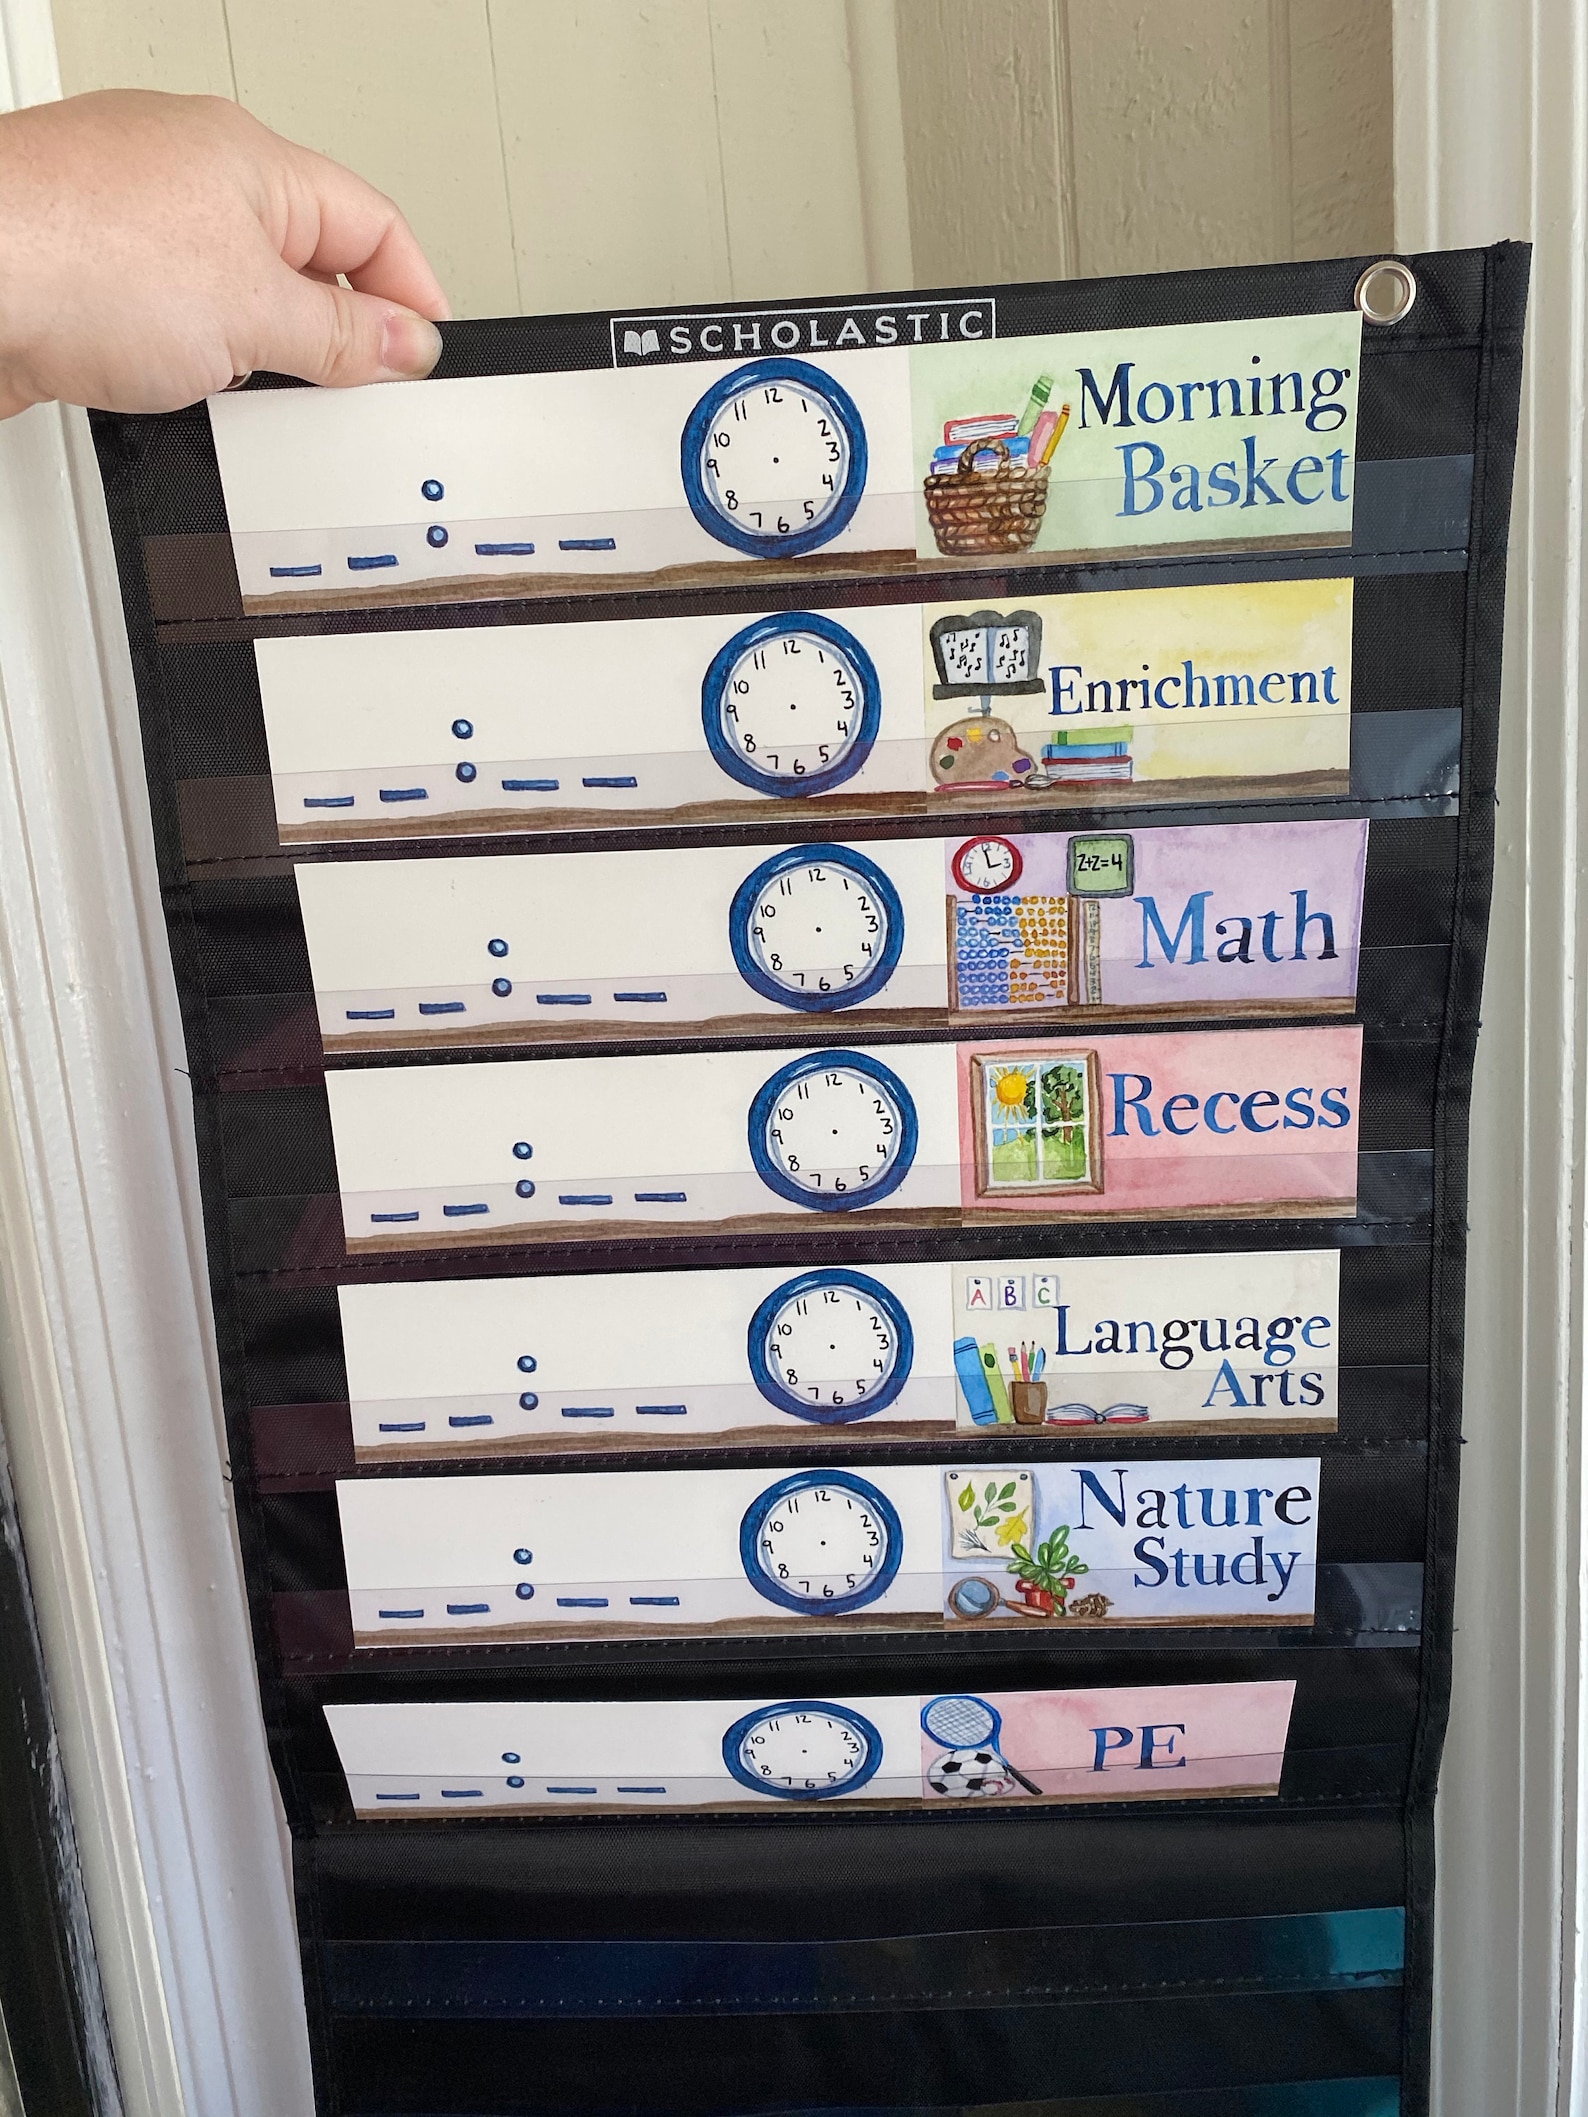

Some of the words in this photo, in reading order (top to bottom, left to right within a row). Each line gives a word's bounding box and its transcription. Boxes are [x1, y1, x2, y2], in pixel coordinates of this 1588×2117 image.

[670, 310, 984, 355] SCHOLASTIC
[764, 387, 784, 404] 12
[1075, 354, 1351, 432] Morning
[734, 399, 747, 422] 11
[801, 398, 808, 413] 1
[817, 419, 831, 437] 2
[713, 432, 731, 448] 10
[825, 441, 841, 462] 3
[705, 458, 721, 478] 9
[1115, 435, 1351, 517] Basket
[822, 473, 834, 492] 4
[725, 489, 739, 511] 8
[803, 500, 815, 521] 5
[749, 512, 762, 529] 7
[777, 516, 790, 534] 6
[783, 639, 801, 655] 12
[753, 650, 766, 671] 11
[818, 650, 824, 664] 1
[833, 669, 846, 686] 2
[733, 679, 750, 695] 10
[1048, 660, 1341, 716] Enrichment
[840, 690, 855, 710] 3
[725, 704, 739, 723] 9
[837, 720, 848, 737] 4
[743, 733, 757, 753] 8
[766, 754, 779, 770] 7
[818, 744, 829, 764] 5
[793, 758, 806, 776] 6
[1003, 857, 1011, 869] 3
[808, 868, 826, 883] 12
[983, 876, 991, 888] 6
[780, 877, 792, 896] 11
[843, 878, 849, 891] 1
[760, 904, 776, 918] 10
[857, 895, 871, 911] 2
[865, 915, 879, 933] 3
[1132, 888, 1340, 969] Math
[752, 926, 766, 944] 9
[861, 942, 873, 958] 4
[770, 953, 783, 971] 8
[792, 972, 805, 987] 7
[843, 964, 854, 982] 5
[818, 976, 831, 992] 6
[825, 1073, 843, 1087] 12
[797, 1082, 809, 1100] 11
[859, 1083, 865, 1095] 1
[872, 1099, 886, 1114] 2
[1105, 1072, 1352, 1139] Recess
[778, 1107, 794, 1121] 10
[879, 1118, 894, 1135] 3
[770, 1129, 784, 1145] 9
[876, 1144, 887, 1159] 4
[787, 1154, 800, 1172] 8
[809, 1173, 822, 1187] 7
[859, 1165, 869, 1182] 5
[834, 1177, 847, 1192] 6
[823, 1290, 841, 1304] 12
[970, 1288, 987, 1306] A
[1004, 1285, 1017, 1306] B
[1037, 1287, 1050, 1304] C
[796, 1299, 808, 1316] 11
[856, 1300, 862, 1311] 1
[777, 1323, 793, 1336] 10
[869, 1316, 882, 1331] 2
[876, 1333, 890, 1350] 3
[1053, 1304, 1331, 1370] Language
[769, 1343, 783, 1360] 9
[873, 1358, 884, 1373] 4
[786, 1368, 798, 1386] 8
[1201, 1358, 1325, 1408] Arts
[807, 1387, 819, 1400] 7
[856, 1378, 866, 1395] 5
[832, 1390, 844, 1405] 6
[814, 1490, 831, 1503] 12
[847, 1499, 852, 1510] 1
[1070, 1468, 1312, 1530] Nature
[788, 1498, 799, 1514] 11
[769, 1520, 784, 1533] 10
[860, 1514, 872, 1528] 2
[761, 1539, 774, 1555] 9
[866, 1531, 880, 1547] 3
[863, 1554, 873, 1569] 4
[1133, 1535, 1302, 1602] Study
[777, 1563, 790, 1580] 8
[798, 1580, 810, 1593] 7
[846, 1573, 856, 1589] 5
[822, 1584, 834, 1598] 6
[769, 1720, 780, 1732] 11
[795, 1714, 812, 1724] 12
[827, 1721, 833, 1729] 1
[750, 1736, 766, 1745] 10
[840, 1731, 853, 1741] 2
[743, 1748, 756, 1760] 9
[847, 1742, 860, 1754] 3
[1086, 1723, 1187, 1773] PE
[760, 1764, 772, 1776] 8
[843, 1758, 854, 1769] 4
[781, 1776, 793, 1786] 7
[804, 1778, 816, 1790] 6
[827, 1771, 837, 1783] 5
